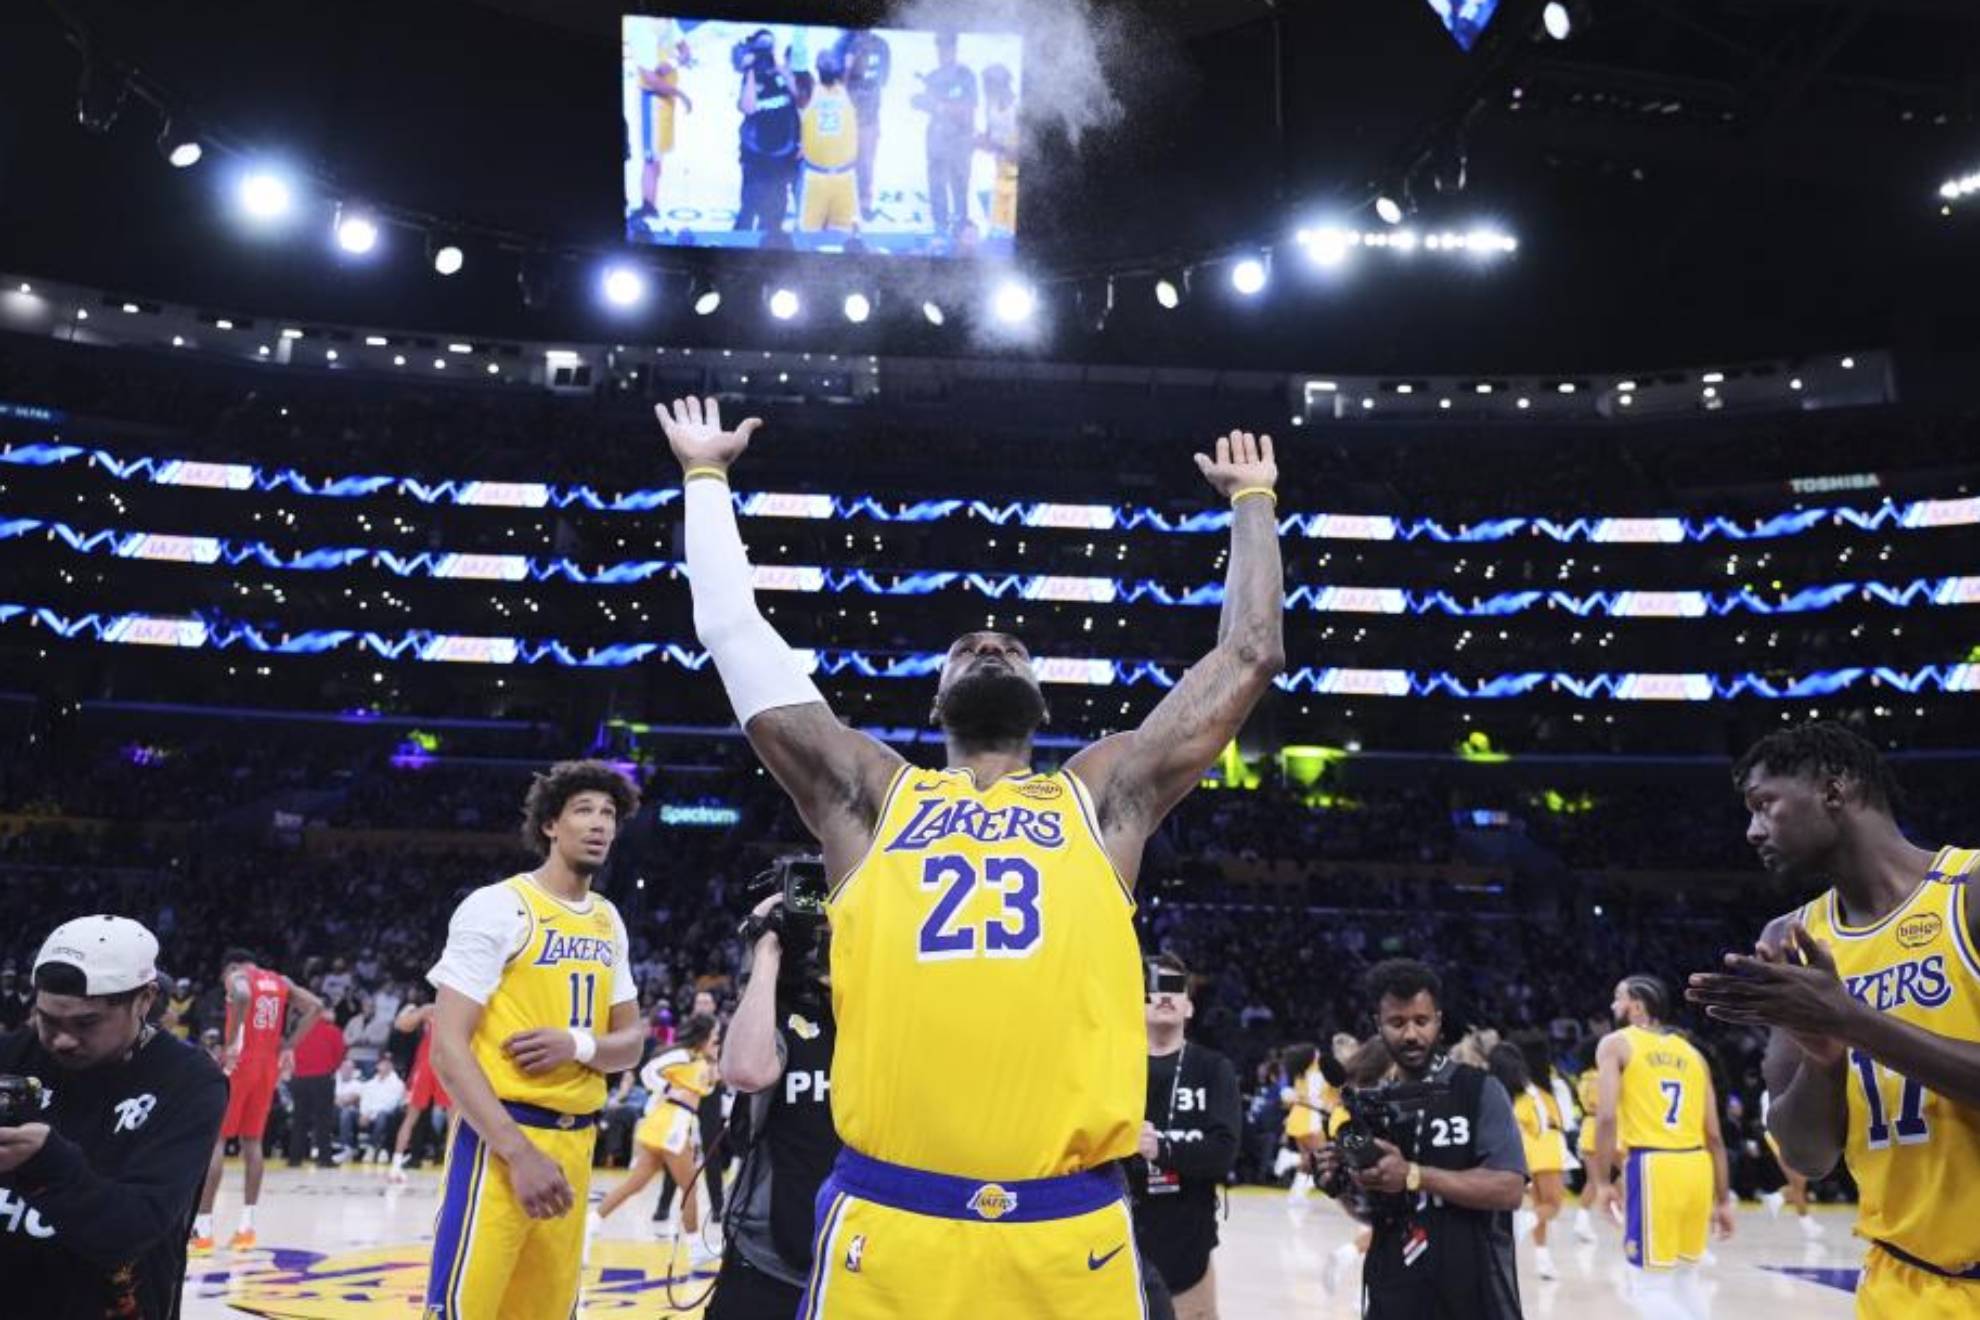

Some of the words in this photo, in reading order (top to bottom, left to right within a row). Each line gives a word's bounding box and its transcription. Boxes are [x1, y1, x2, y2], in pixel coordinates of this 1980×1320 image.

[1790, 473, 1880, 493] TOSHIBA
[660, 804, 737, 825] Spectrum
[884, 798, 1065, 852] LAKERS
[918, 854, 1042, 957] 23
[569, 972, 595, 1028] 11
[1846, 955, 1952, 1011] KERS
[1176, 1087, 1206, 1111] 31
[1660, 1080, 1682, 1124] 7
[1430, 1116, 1470, 1147] 23
